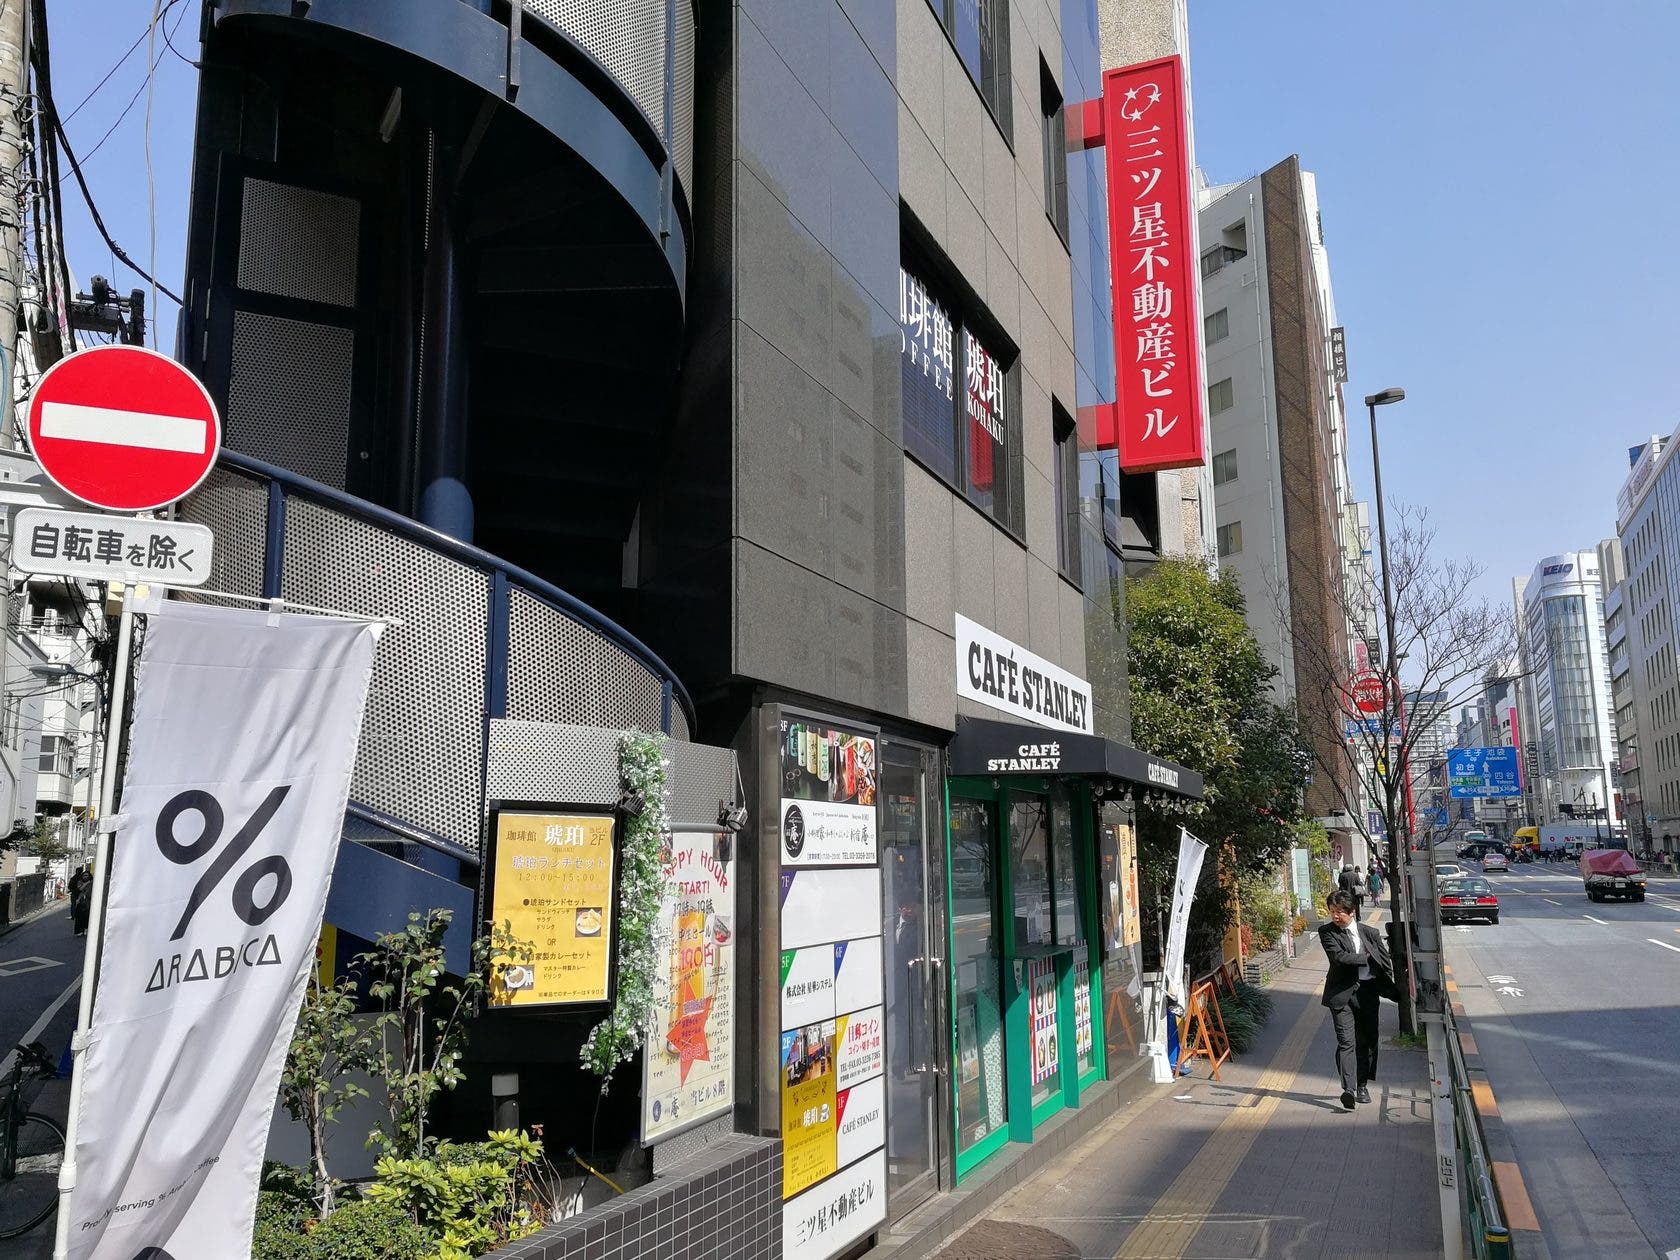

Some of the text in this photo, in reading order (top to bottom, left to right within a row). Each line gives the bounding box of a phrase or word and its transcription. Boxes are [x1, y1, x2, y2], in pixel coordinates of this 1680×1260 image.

[1126, 124, 1179, 442] 三ツ星不動産ビル
[966, 329, 1003, 420] 琥珀
[967, 391, 1004, 446] KOHAKU
[30, 524, 195, 572] 自転車を除く
[1543, 563, 1574, 577] KEIO
[968, 641, 1087, 730] CAFÉ STANLEY
[1018, 741, 1060, 757] CAFÉ
[987, 757, 1060, 771] STANLEY
[1528, 750, 1538, 778] FOREVER
[506, 823, 585, 847] 珈琲館 琥珀
[590, 833, 606, 847] 2F
[700, 850, 728, 893] HOUR
[781, 875, 790, 888] 7F
[546, 938, 557, 946] OR
[144, 934, 282, 993] ARABICA
[680, 942, 714, 968] 190円
[781, 955, 790, 968] 5F
[786, 984, 806, 999] 株式会社
[838, 1096, 845, 1109] 1F
[841, 1107, 880, 1135] CAFÉ STANLEY
[115, 1198, 155, 1214] serving
[794, 1180, 875, 1247] 三ツ星不動産ビル
